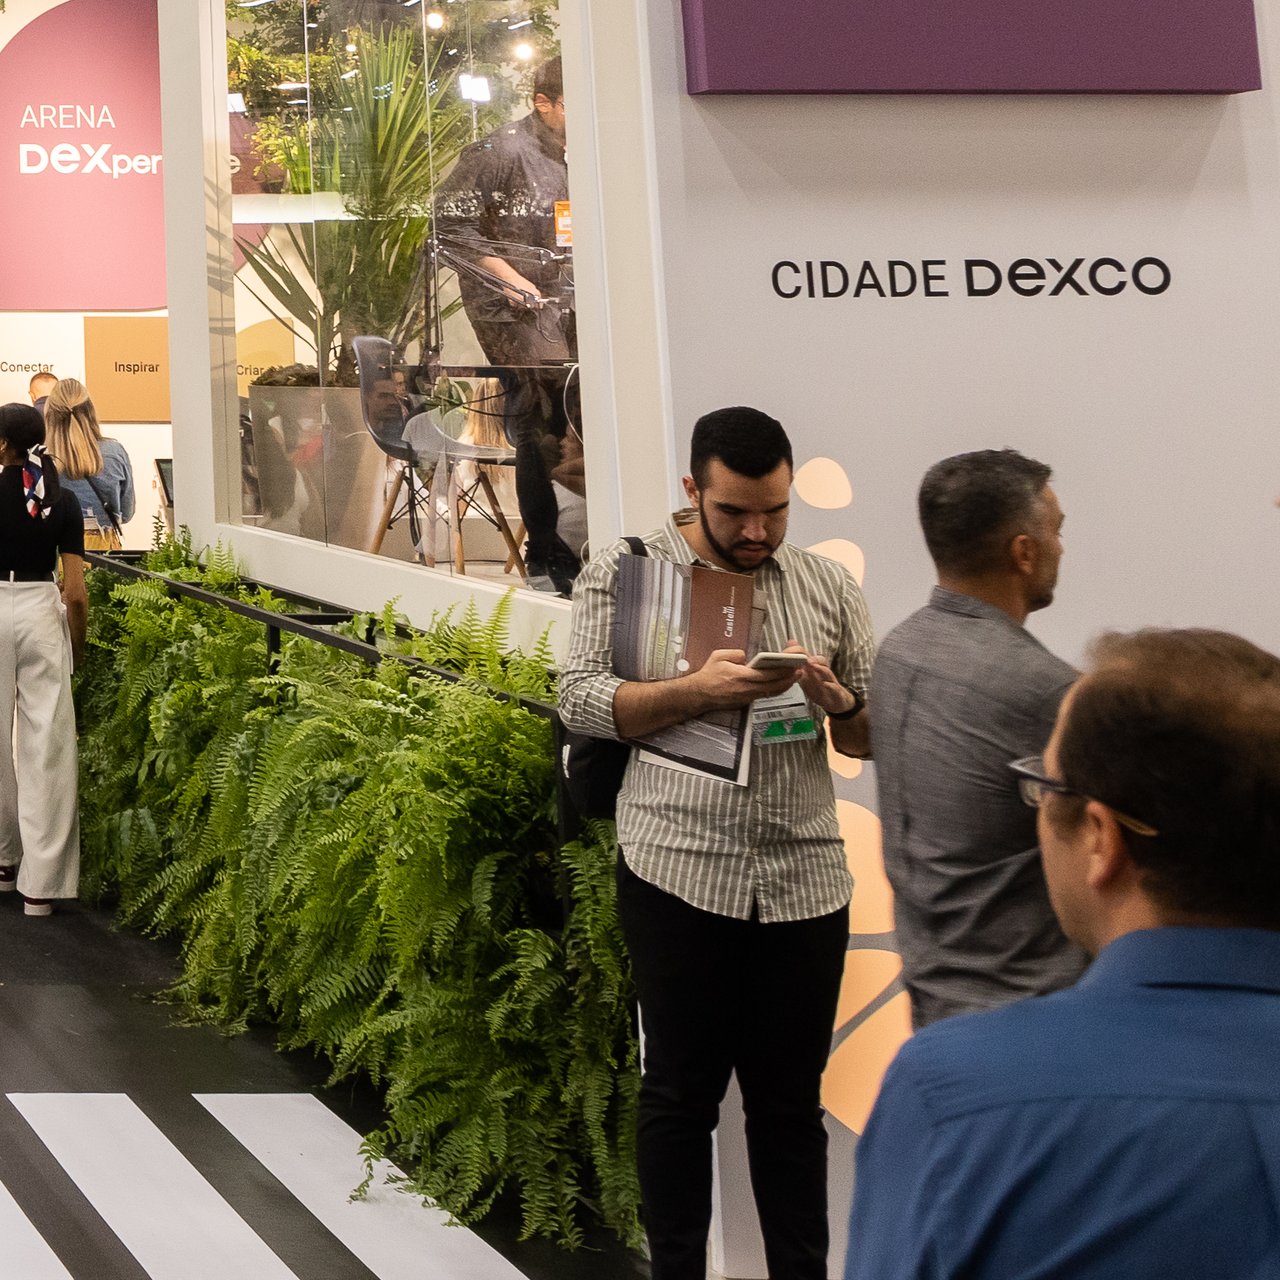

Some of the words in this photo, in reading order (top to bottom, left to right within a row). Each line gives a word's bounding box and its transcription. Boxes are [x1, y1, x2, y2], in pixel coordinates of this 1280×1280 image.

[20, 104, 116, 128] ARENA
[771, 260, 949, 299] CIDADE
[964, 257, 1171, 297] Dexco
[0, 361, 54, 373] Conectar
[114, 361, 159, 375] Inspirar
[236, 364, 264, 376] Criar
